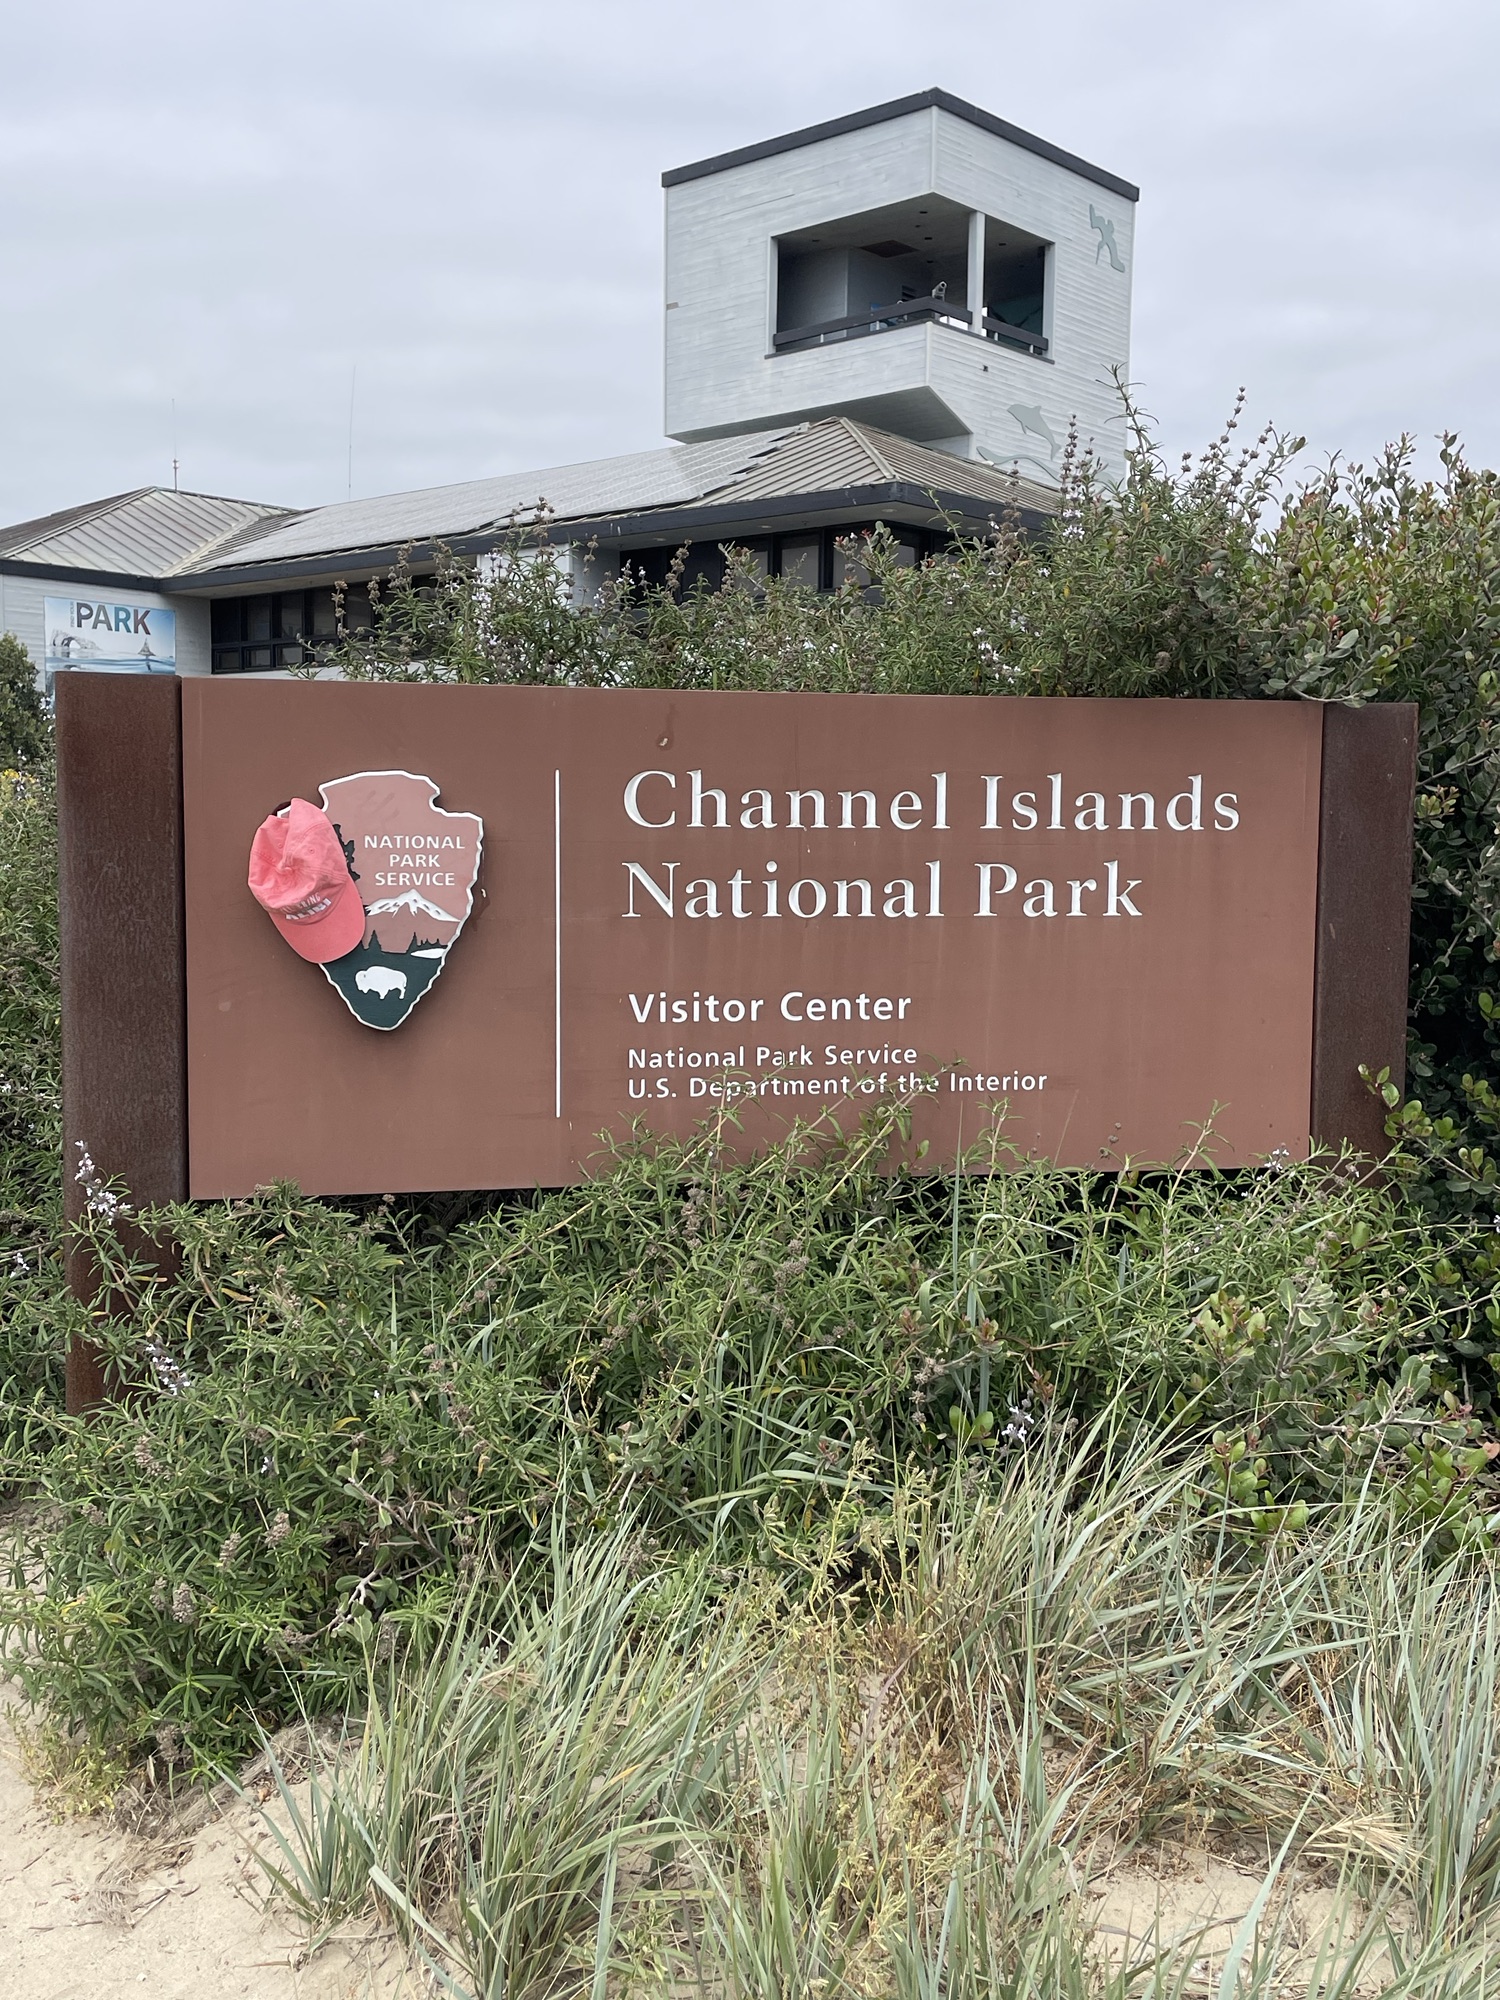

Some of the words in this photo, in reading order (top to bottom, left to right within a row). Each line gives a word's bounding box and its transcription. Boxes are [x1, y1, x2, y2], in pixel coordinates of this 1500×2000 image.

[76, 602, 151, 635] PARK
[623, 769, 951, 830] Channel
[979, 772, 1240, 831] Islands
[364, 835, 466, 850] NATIONAL
[389, 853, 441, 868] PARK
[374, 872, 456, 887] SERVICE
[621, 860, 945, 919] National
[973, 860, 1143, 918] Park
[628, 991, 764, 1023] Visitor
[780, 991, 912, 1022] Center
[628, 1045, 744, 1069] National
[756, 1044, 814, 1067] Park
[824, 1043, 918, 1066] Service
[628, 1077, 677, 1099] U.S.
[689, 1074, 850, 1102] Department
[859, 1072, 888, 1094] of
[950, 1069, 1048, 1092] Interior
